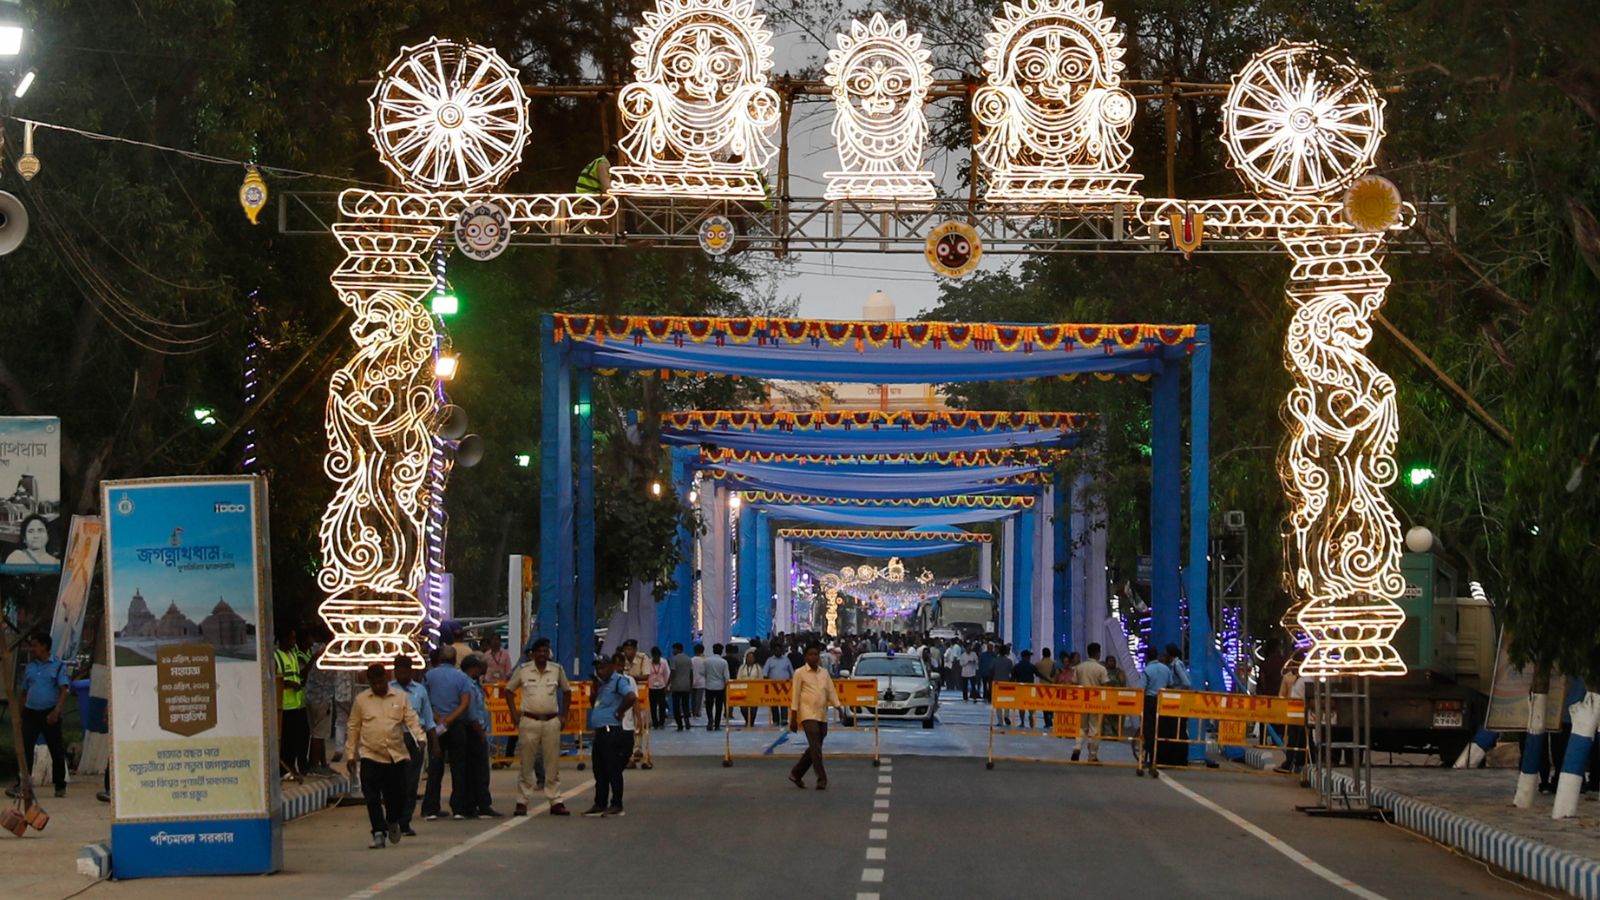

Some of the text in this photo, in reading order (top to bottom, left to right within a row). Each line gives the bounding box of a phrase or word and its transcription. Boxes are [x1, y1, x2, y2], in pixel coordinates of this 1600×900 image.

[136, 545, 220, 567] জগন্নাথধাম
[166, 762, 182, 771] এক
[184, 761, 203, 773] নতুন
[150, 831, 234, 846] পশ্চিমবঙ্গ সরকার
